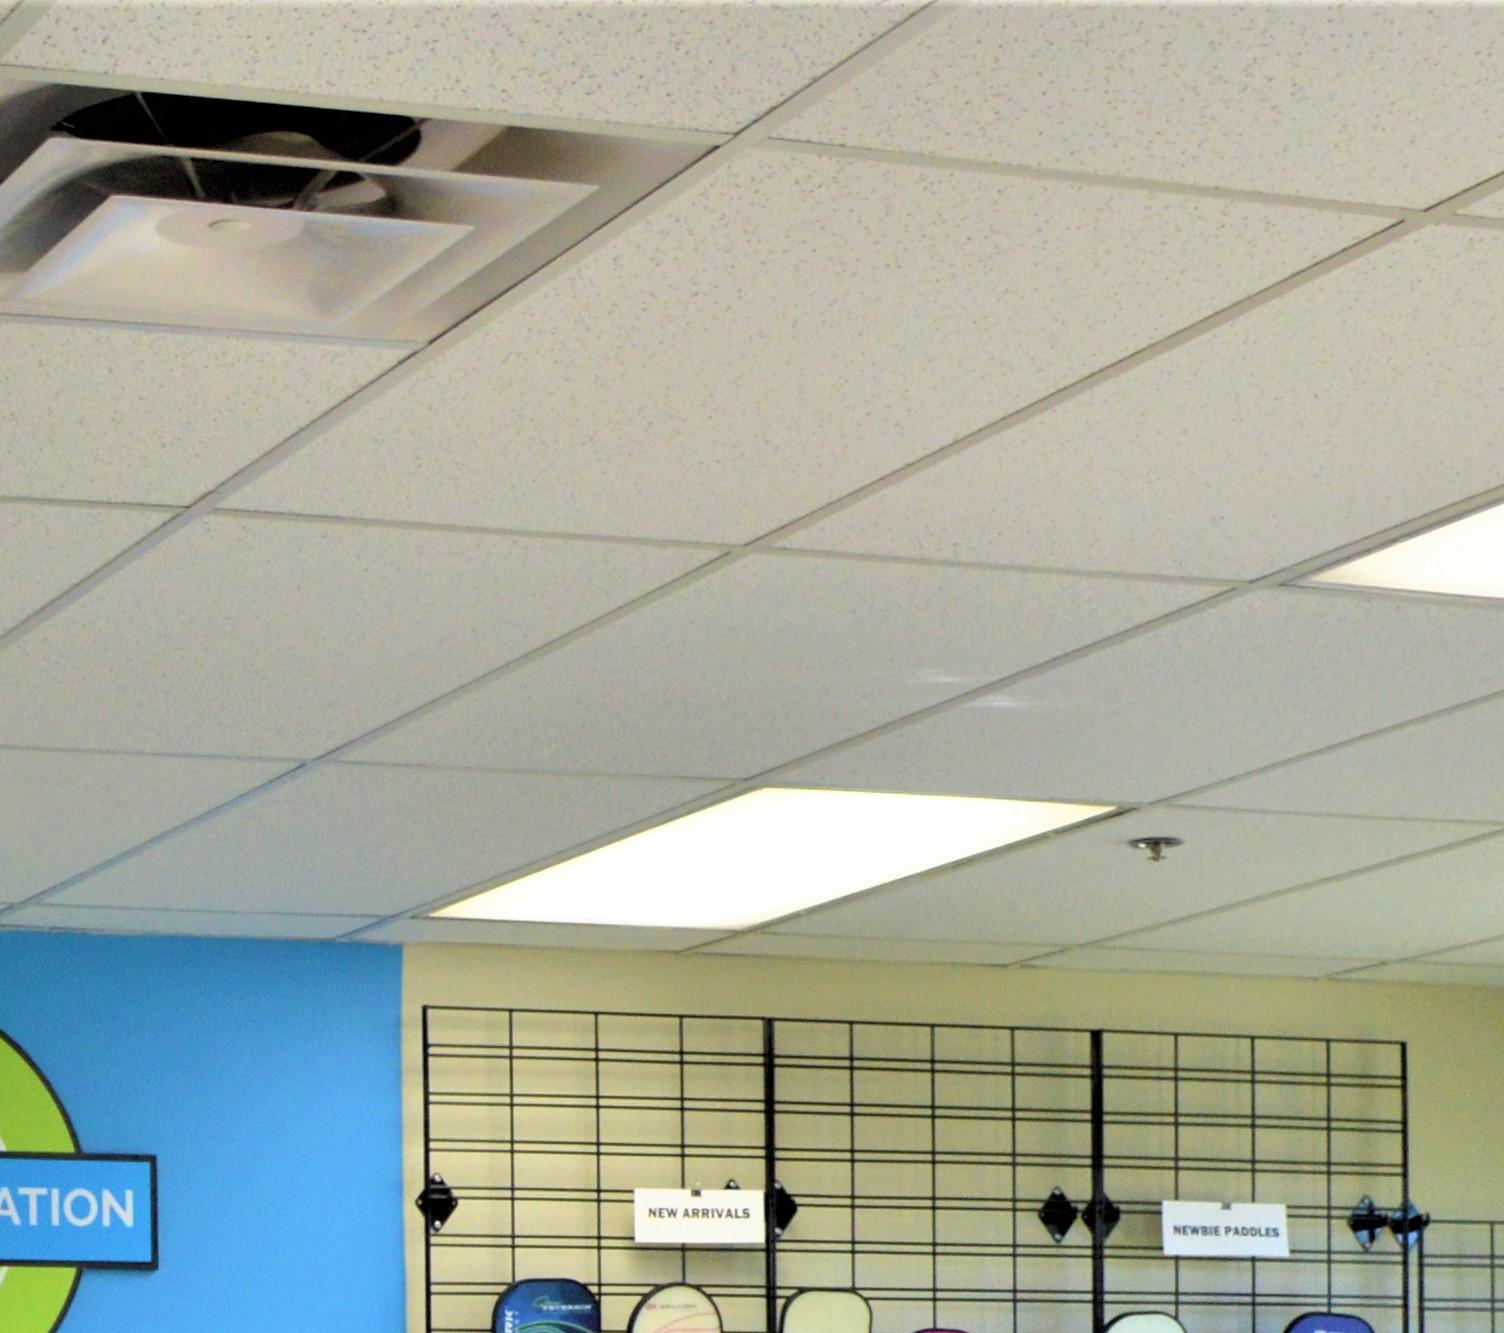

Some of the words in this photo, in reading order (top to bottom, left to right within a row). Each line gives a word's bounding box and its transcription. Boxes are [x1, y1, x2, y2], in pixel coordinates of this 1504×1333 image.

[648, 1207, 678, 1219] NEW
[682, 1207, 751, 1219] ARRIVALS
[1173, 1225, 1221, 1236] NEWBIE
[1224, 1226, 1280, 1238] PADDLES
